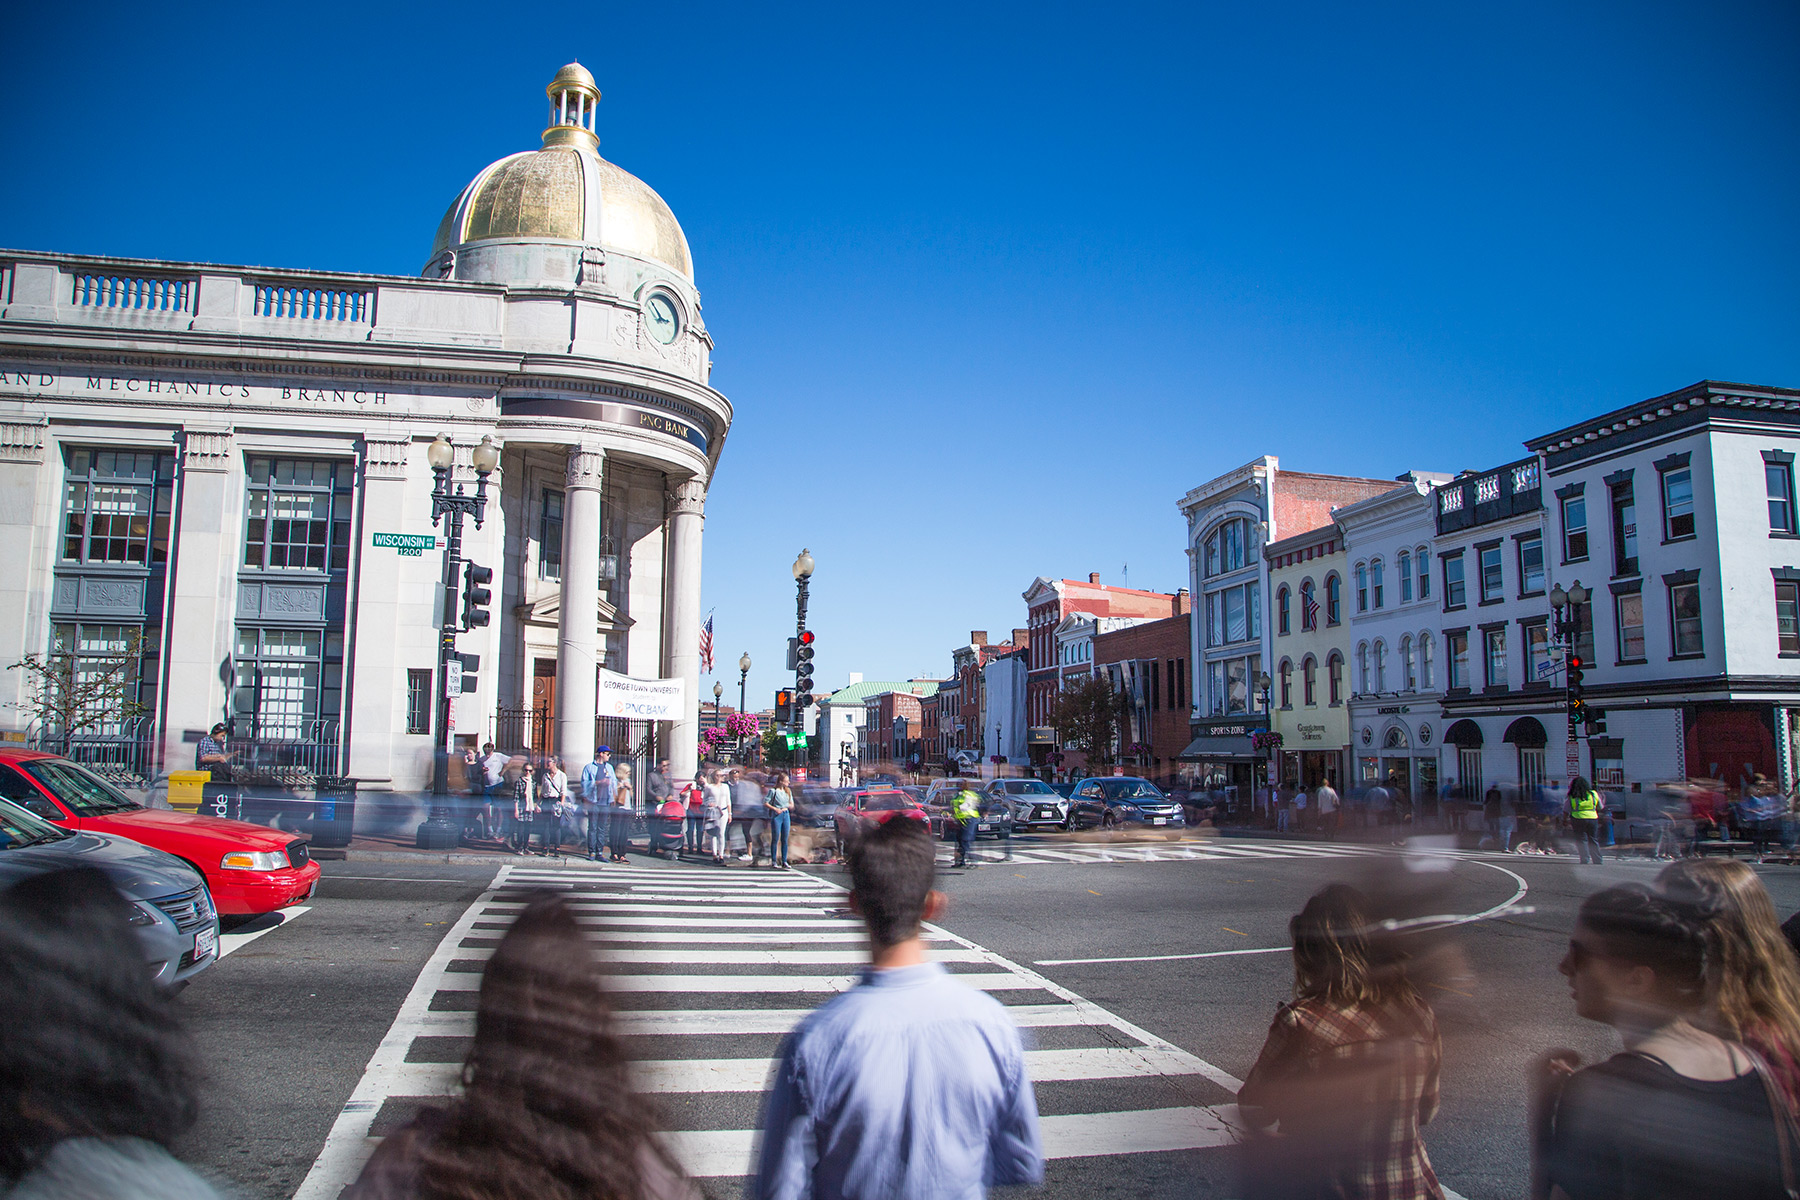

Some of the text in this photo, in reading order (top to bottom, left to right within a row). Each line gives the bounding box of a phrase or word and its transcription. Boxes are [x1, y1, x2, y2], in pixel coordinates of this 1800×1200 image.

[0, 372, 387, 405] AND MECHANICS BRANCH
[640, 413, 688, 438] PNC BANK
[375, 535, 425, 547] WISCONSIN
[399, 548, 421, 556] 1200
[603, 681, 680, 694] GEORGETOWN UNIVERSITY
[1210, 726, 1230, 735] SPORTS
[1230, 725, 1245, 734] ZONE
